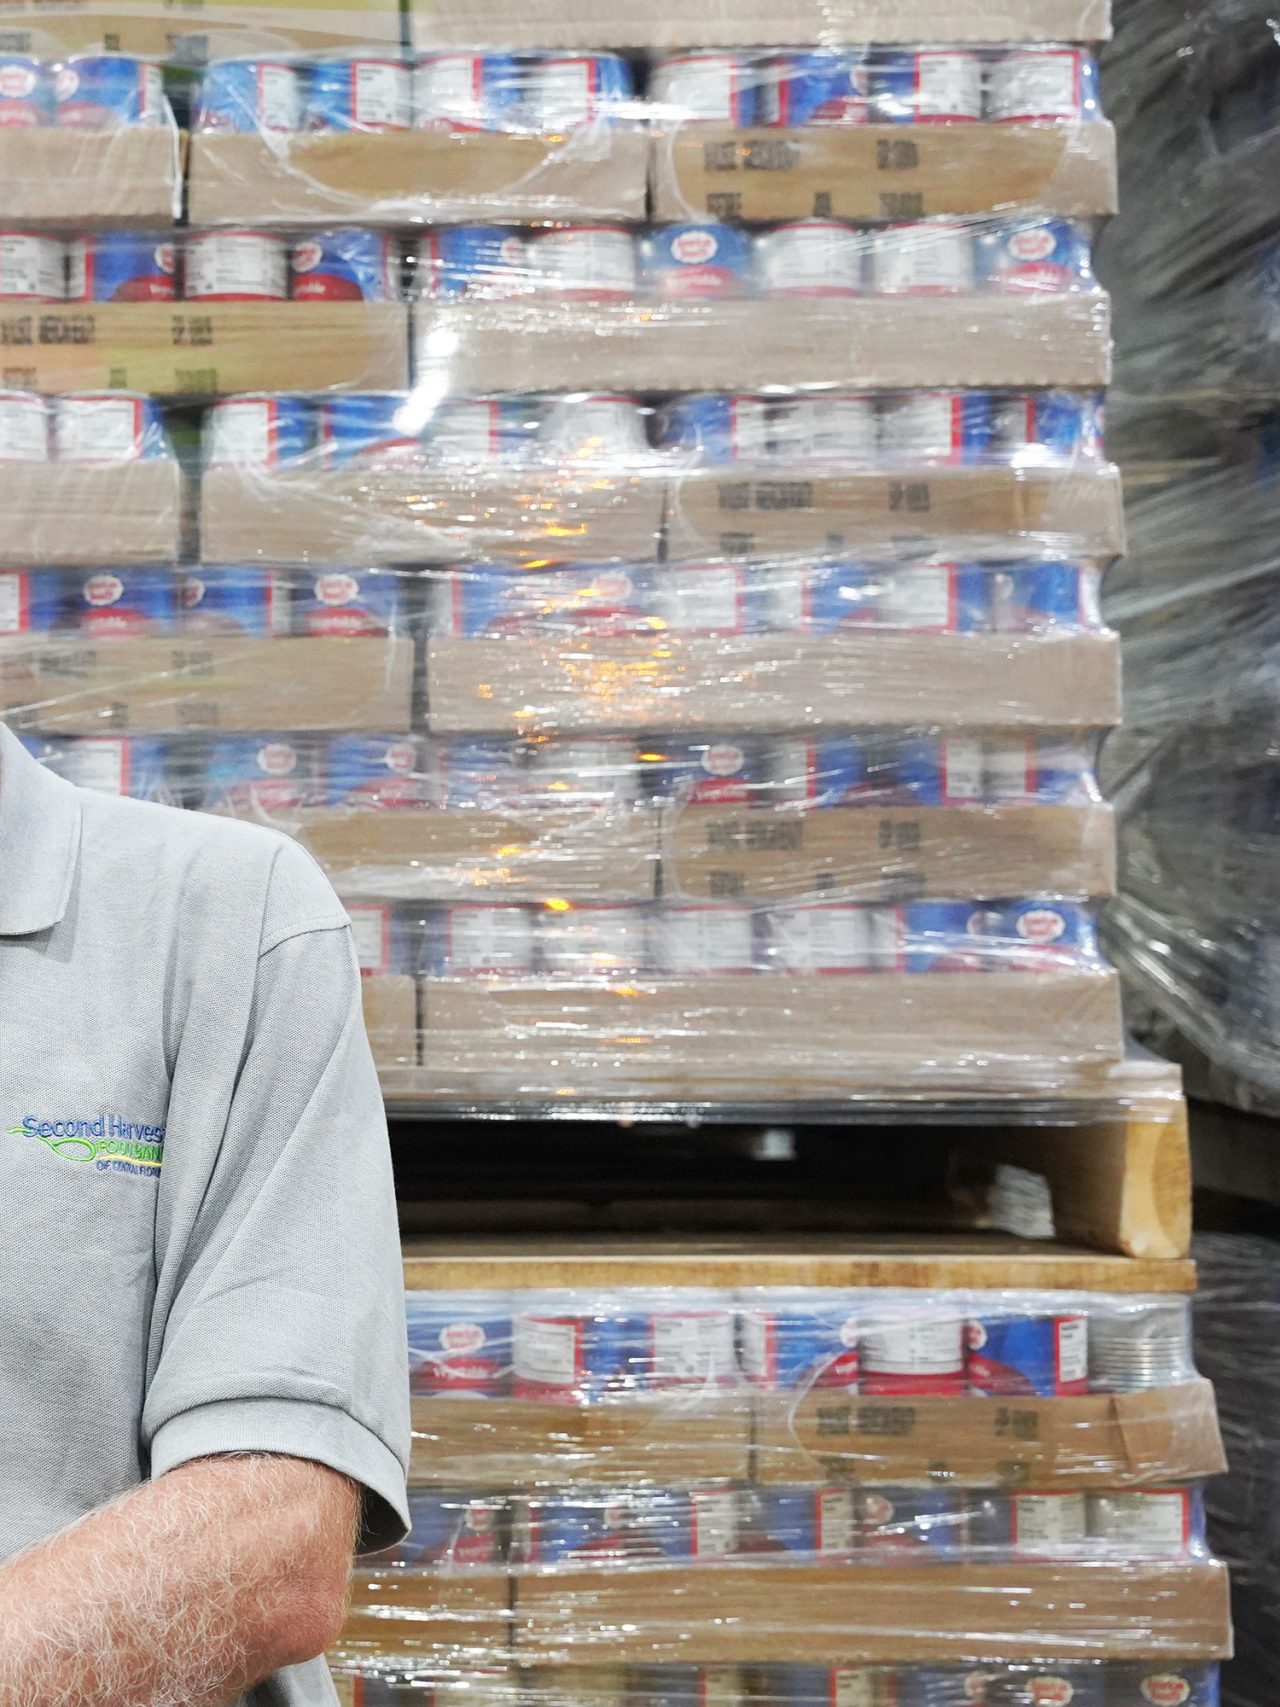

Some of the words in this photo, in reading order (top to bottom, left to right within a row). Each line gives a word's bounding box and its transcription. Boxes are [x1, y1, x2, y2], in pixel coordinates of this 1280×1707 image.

[22, 1113, 105, 1137] Second
[135, 1143, 164, 1162] BAN
[96, 1160, 111, 1171] OF
